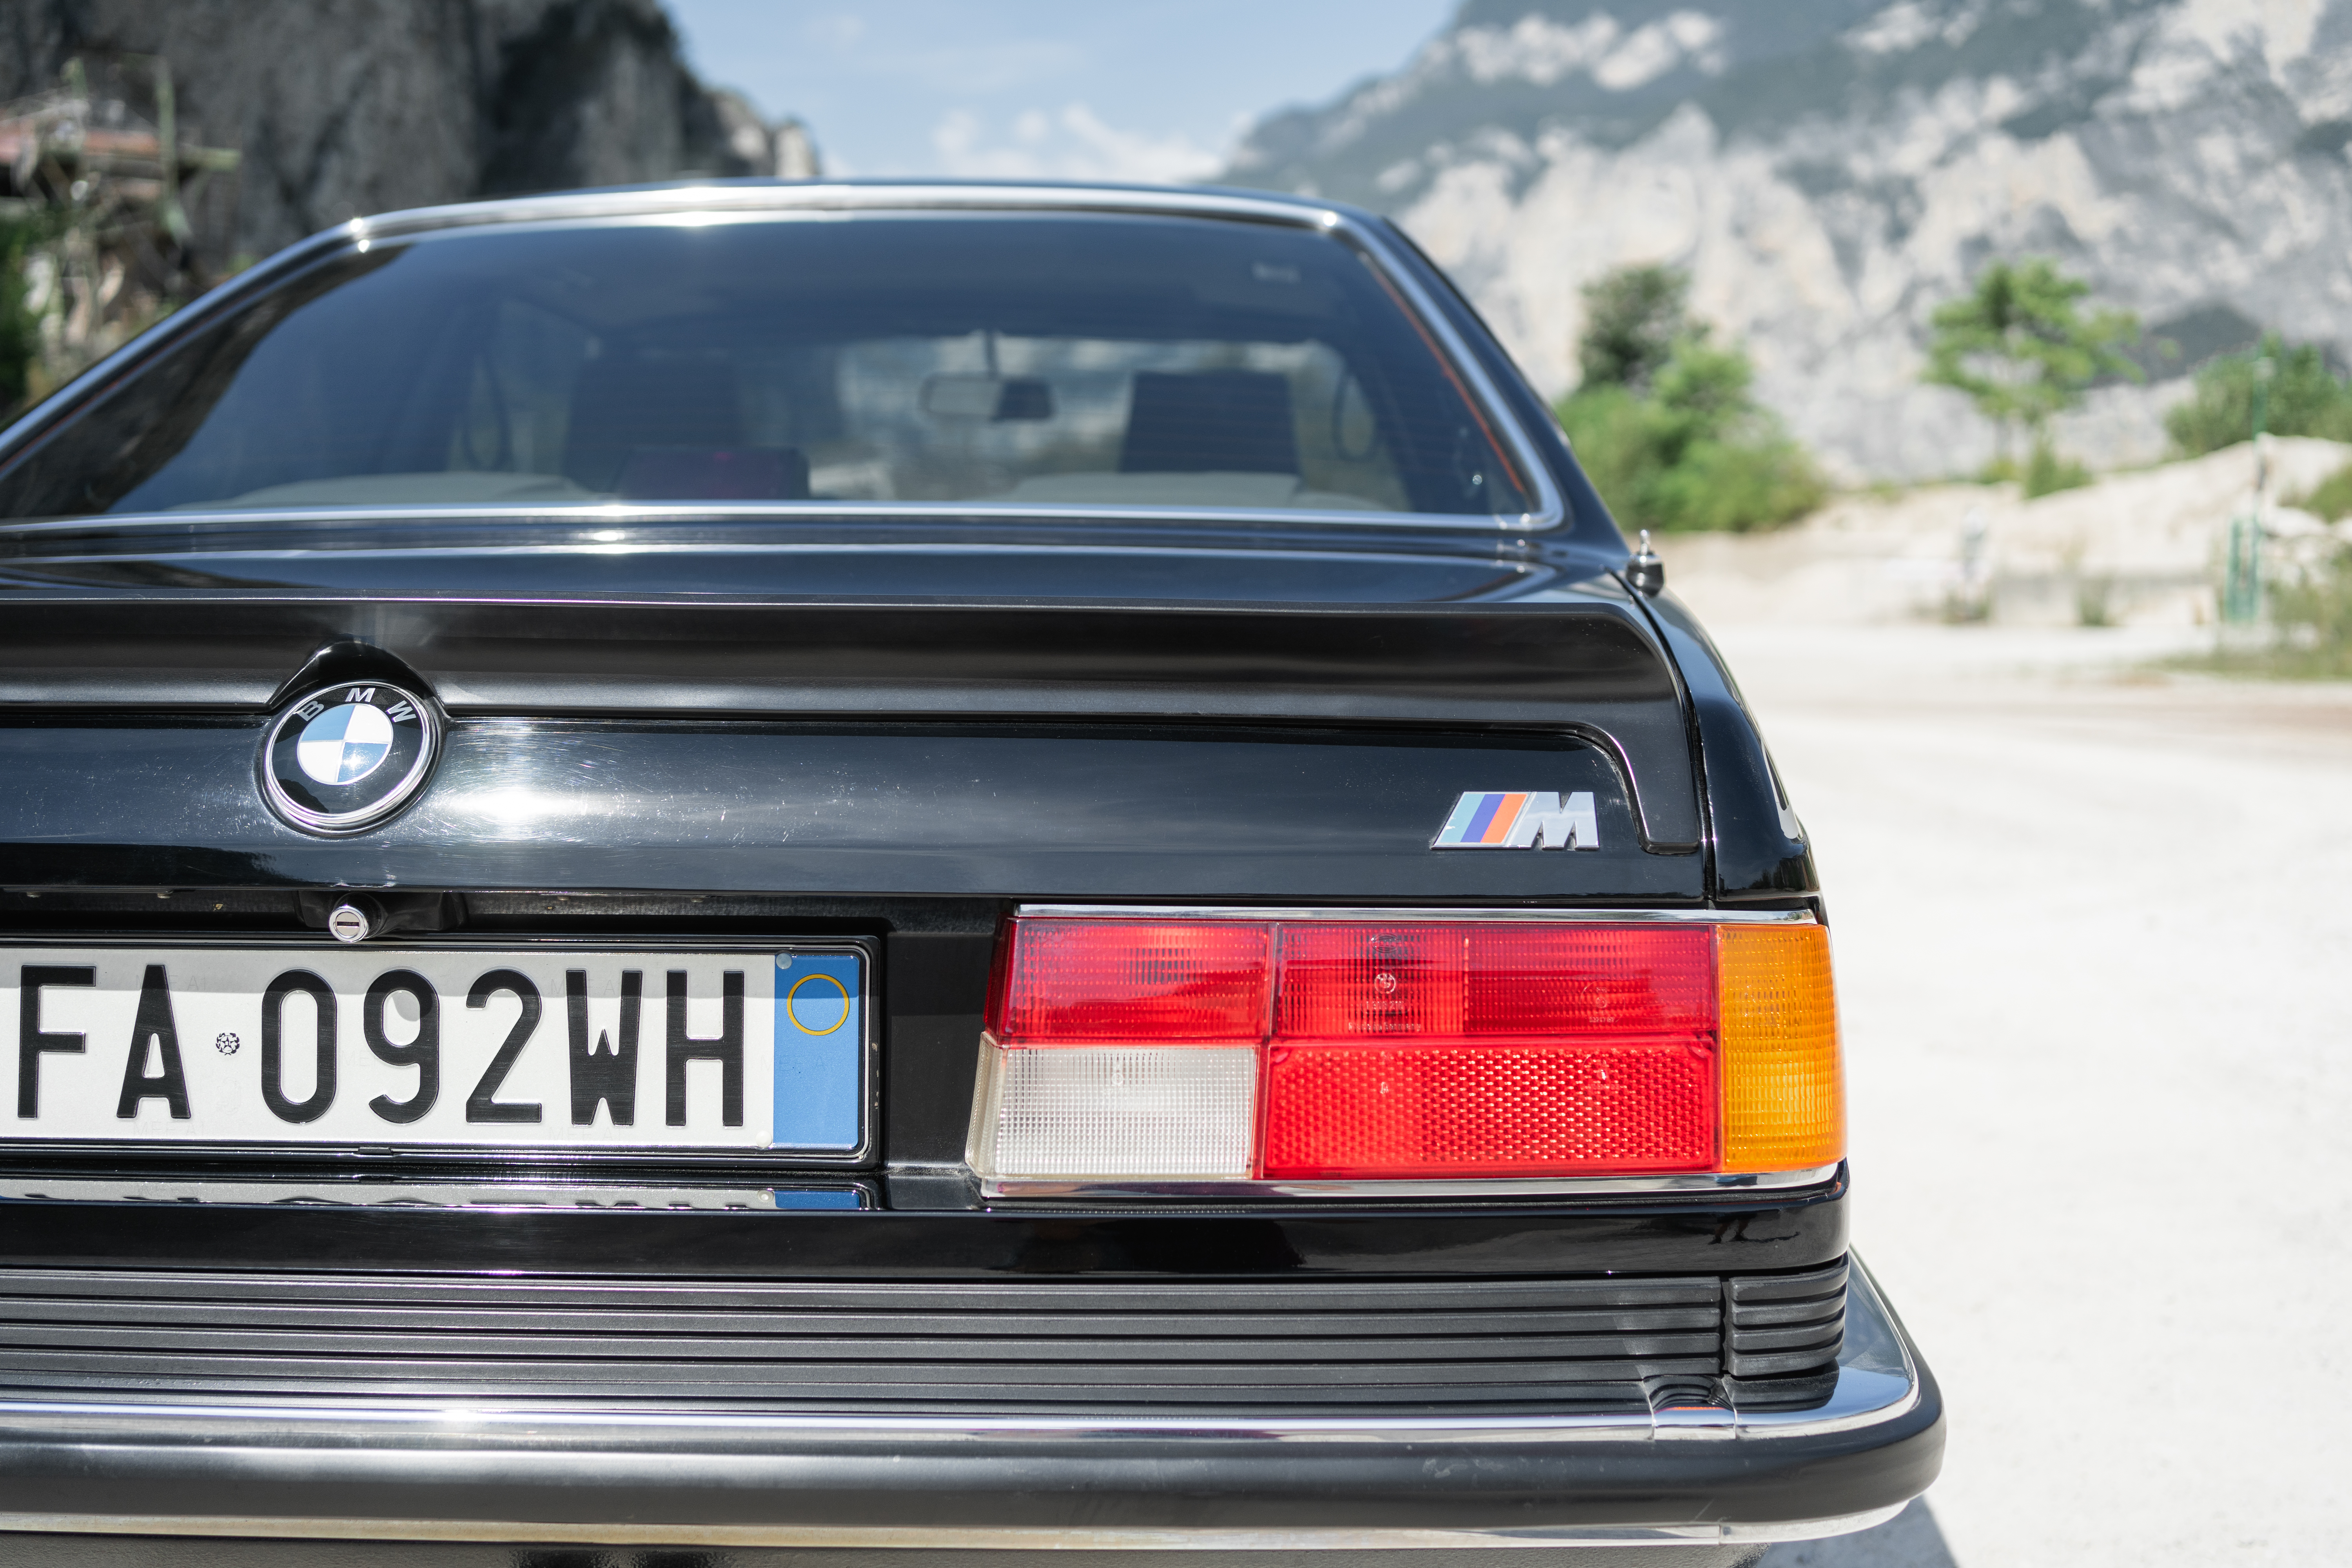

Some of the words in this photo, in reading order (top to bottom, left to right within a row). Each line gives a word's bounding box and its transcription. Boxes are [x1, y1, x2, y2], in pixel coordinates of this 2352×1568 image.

[294, 688, 417, 722] BMW
[1504, 791, 1600, 850] M
[18, 964, 191, 1119] FA
[261, 968, 744, 1127] 092WH
